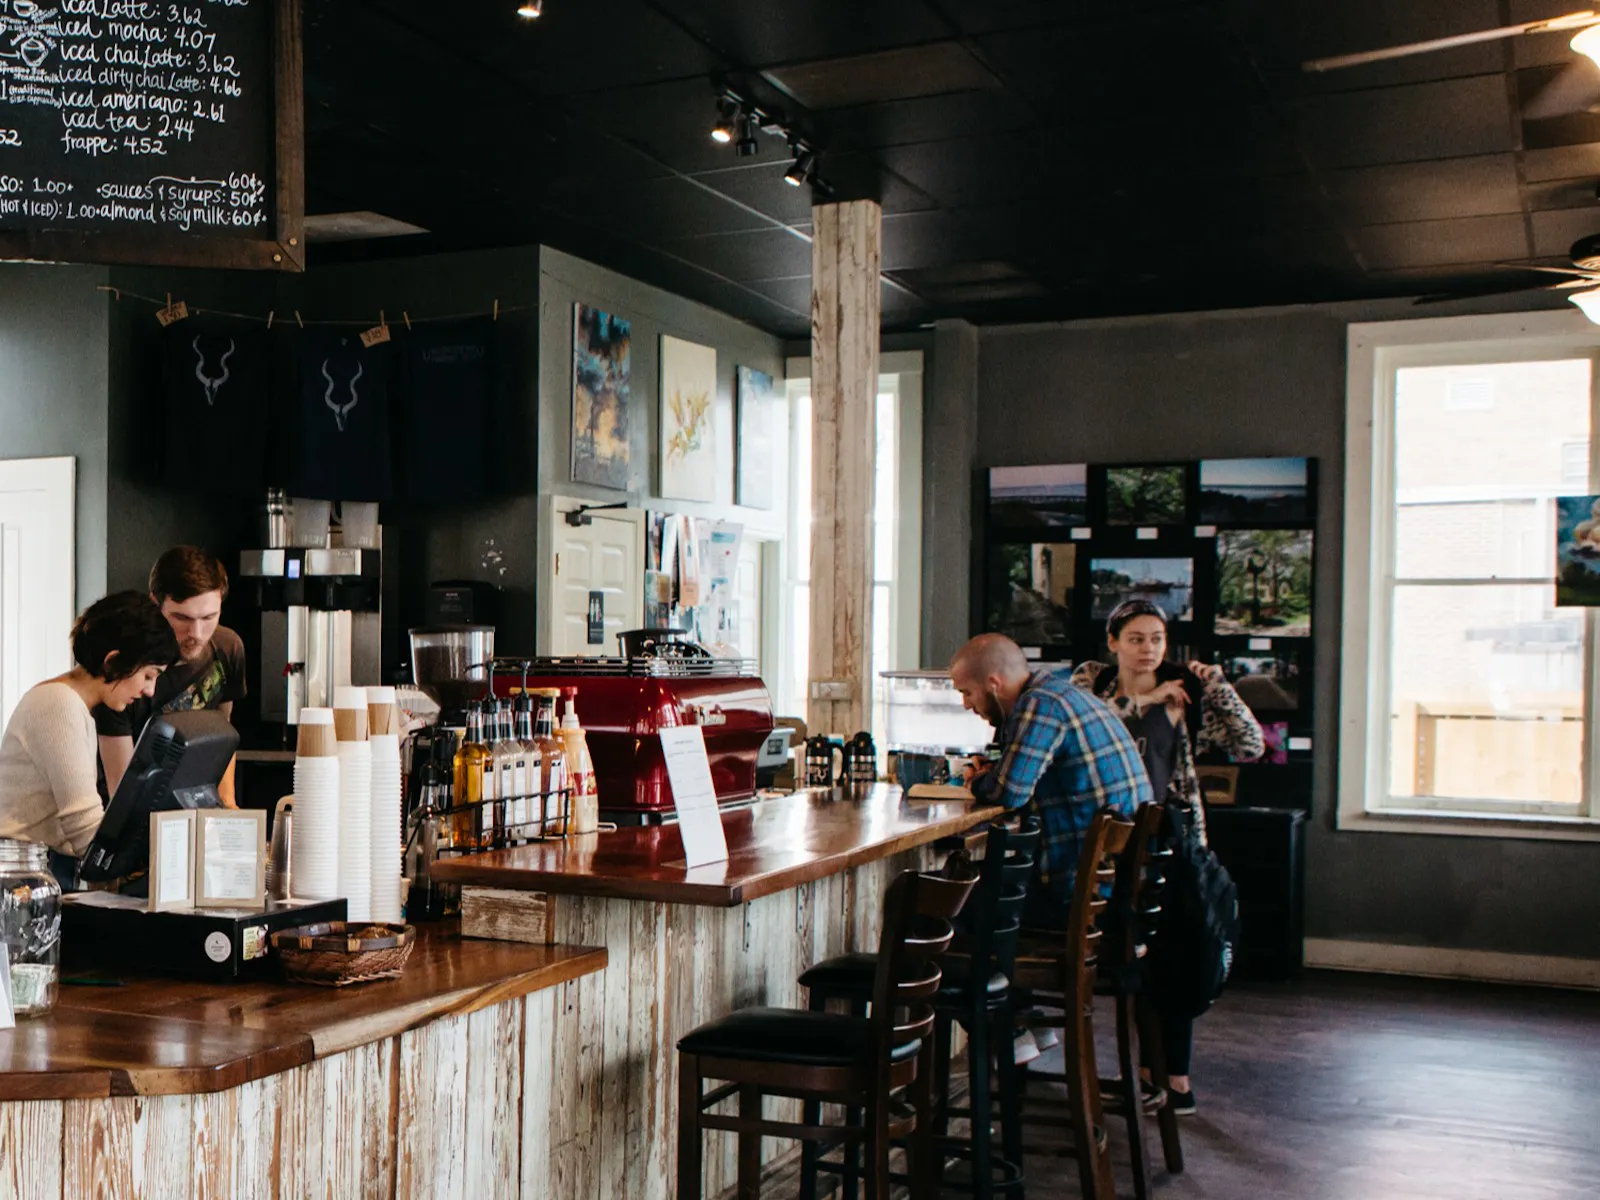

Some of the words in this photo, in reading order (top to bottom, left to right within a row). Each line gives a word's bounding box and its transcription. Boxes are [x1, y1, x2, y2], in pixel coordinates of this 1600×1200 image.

[167, 5, 207, 28] 3.62
[58, 16, 103, 39] iced
[109, 22, 167, 42] mocha:
[175, 27, 217, 53] 4.07
[60, 40, 100, 63] iced
[104, 43, 143, 66] chai
[196, 54, 240, 76] 3.62
[59, 65, 97, 85] iced
[98, 66, 134, 94] dirty
[135, 72, 167, 90] chai
[210, 76, 241, 97] 4.66
[61, 87, 100, 109] iced
[102, 91, 188, 114] americano:
[194, 100, 226, 123] 2.61
[62, 107, 105, 130] iced
[106, 111, 152, 132] tea:
[158, 115, 195, 142] 2.44
[61, 129, 118, 157] frappe:
[124, 136, 167, 155] 4.52
[33, 177, 66, 194] 1.00
[101, 183, 153, 200] sauces
[168, 186, 226, 209] syrups:
[66, 202, 95, 219] 1.00
[101, 203, 156, 224] almond
[168, 207, 192, 231] soy
[193, 206, 231, 226] milk:
